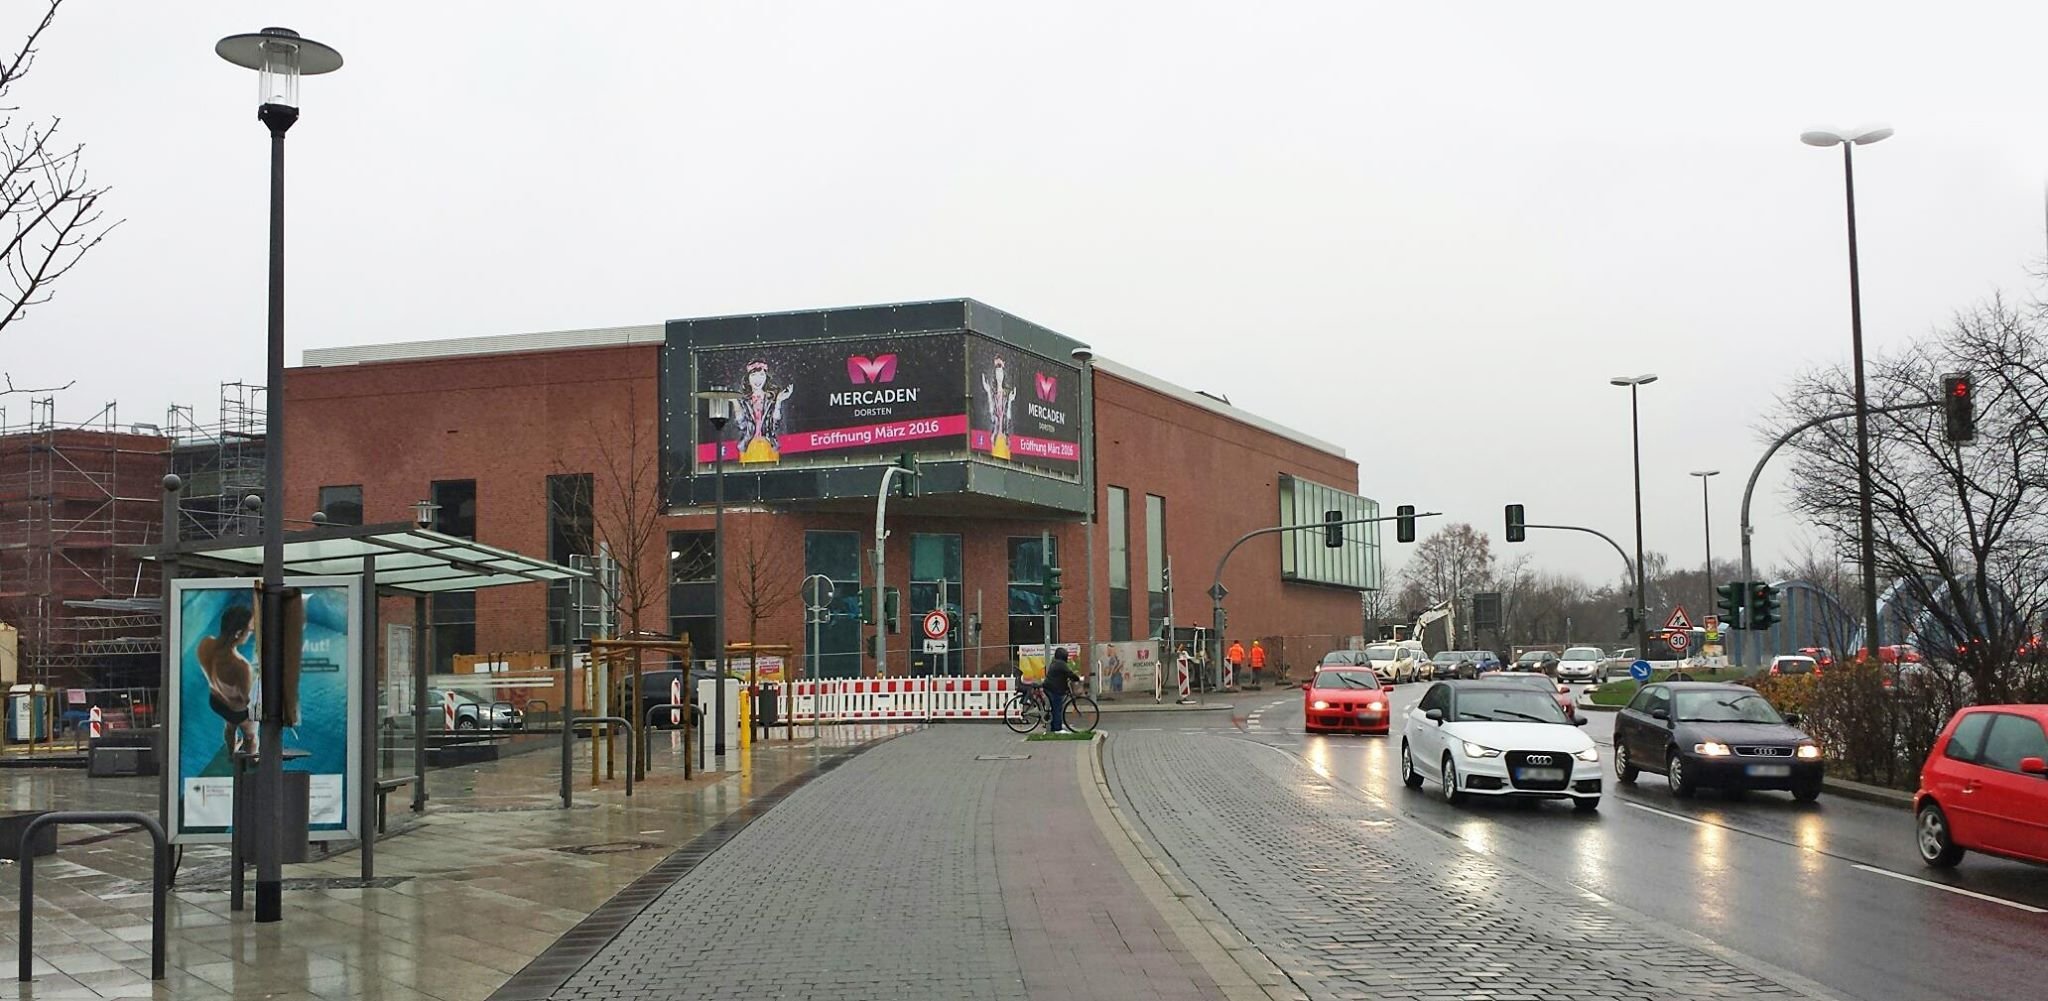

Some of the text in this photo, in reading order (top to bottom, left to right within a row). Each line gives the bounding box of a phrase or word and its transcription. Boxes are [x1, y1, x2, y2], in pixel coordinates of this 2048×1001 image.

[829, 388, 917, 406] MERCADEN
[854, 407, 892, 417] DORSTEN
[1028, 402, 1065, 425] MERCADEN
[810, 421, 939, 447] Eröffnung März 2016
[1020, 439, 1047, 456] Eröffnung
[1672, 636, 1685, 645] 30
